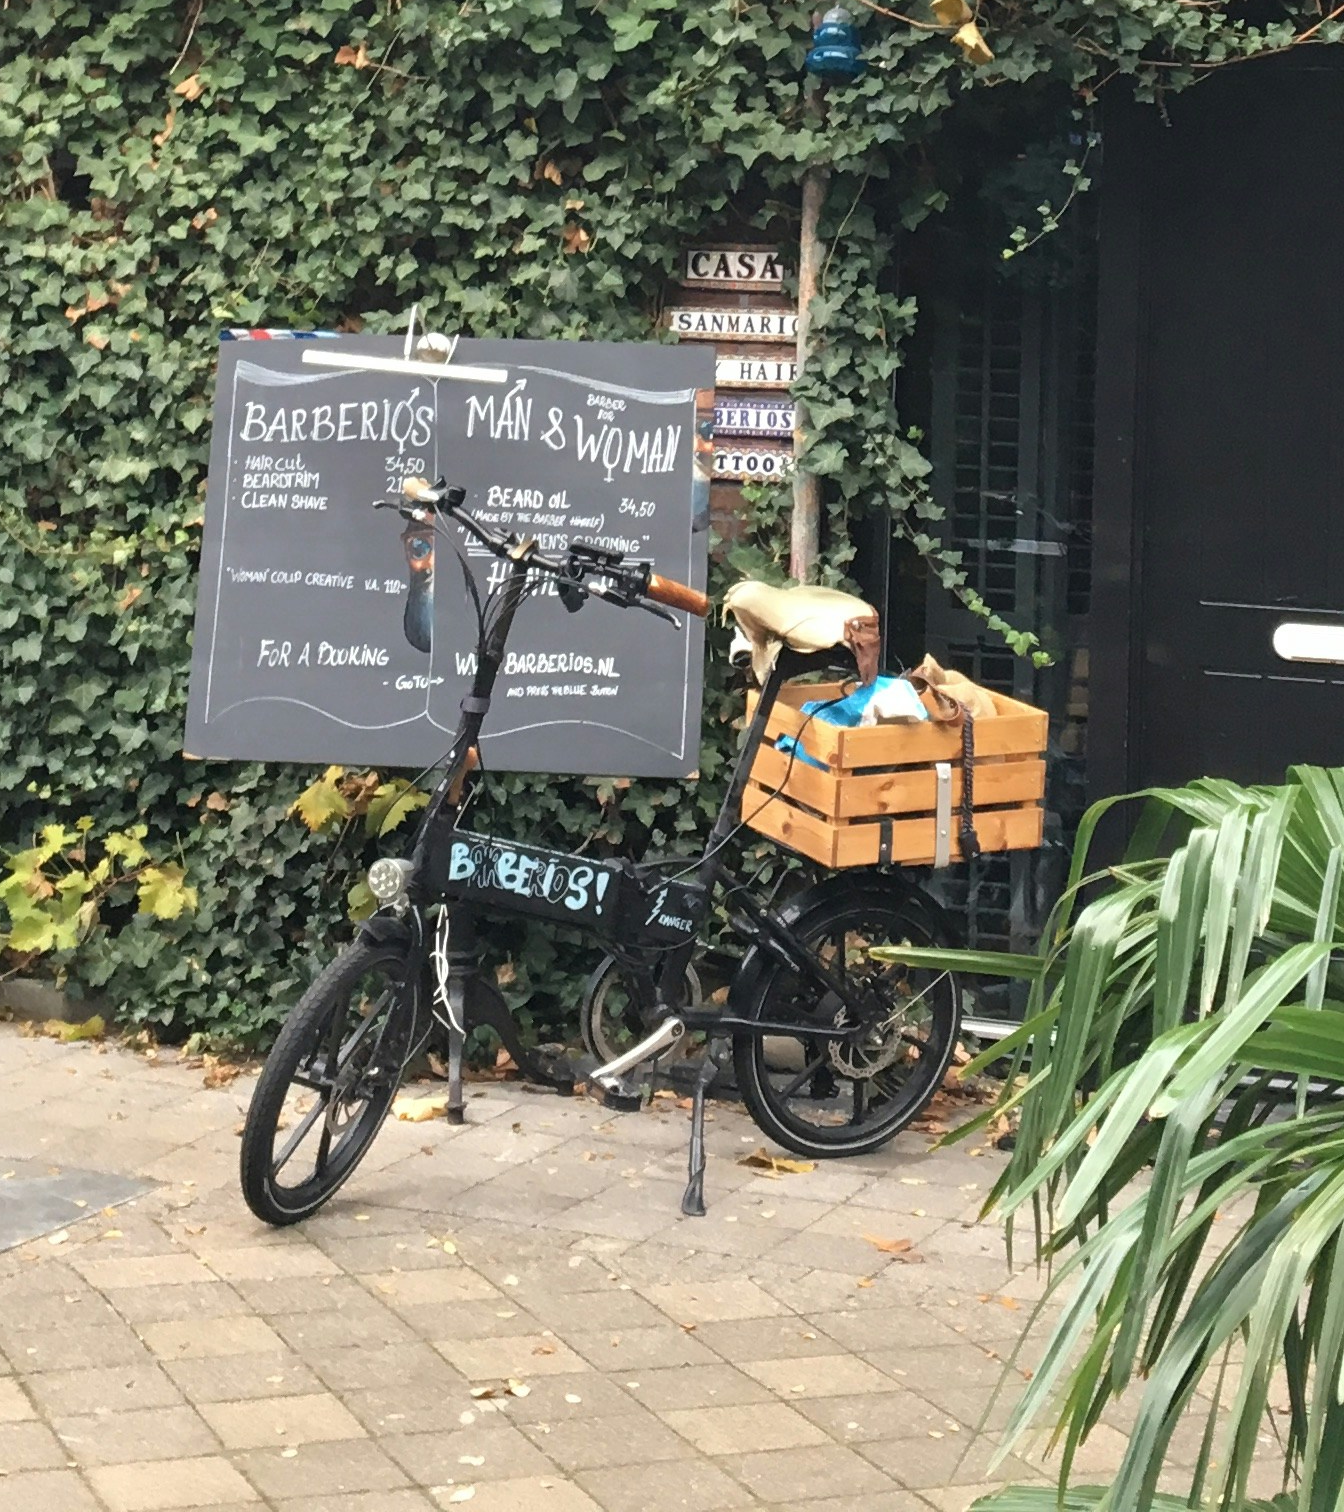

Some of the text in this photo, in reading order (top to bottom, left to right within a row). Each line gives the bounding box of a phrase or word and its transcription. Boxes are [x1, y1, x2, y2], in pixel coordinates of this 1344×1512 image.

[691, 251, 780, 279] CASA
[240, 394, 434, 451] BARBERIOS
[466, 390, 682, 478] MAN & WOMAN
[242, 471, 320, 489] BEARDTRIM
[241, 490, 329, 511] CLEAN SHAVE
[487, 485, 656, 519] BEARD OIL 34,50
[305, 572, 355, 590] CREATIVE
[298, 641, 310, 667] A
[317, 641, 390, 667] BOOKING
[448, 841, 611, 916] BARBERIOS!
